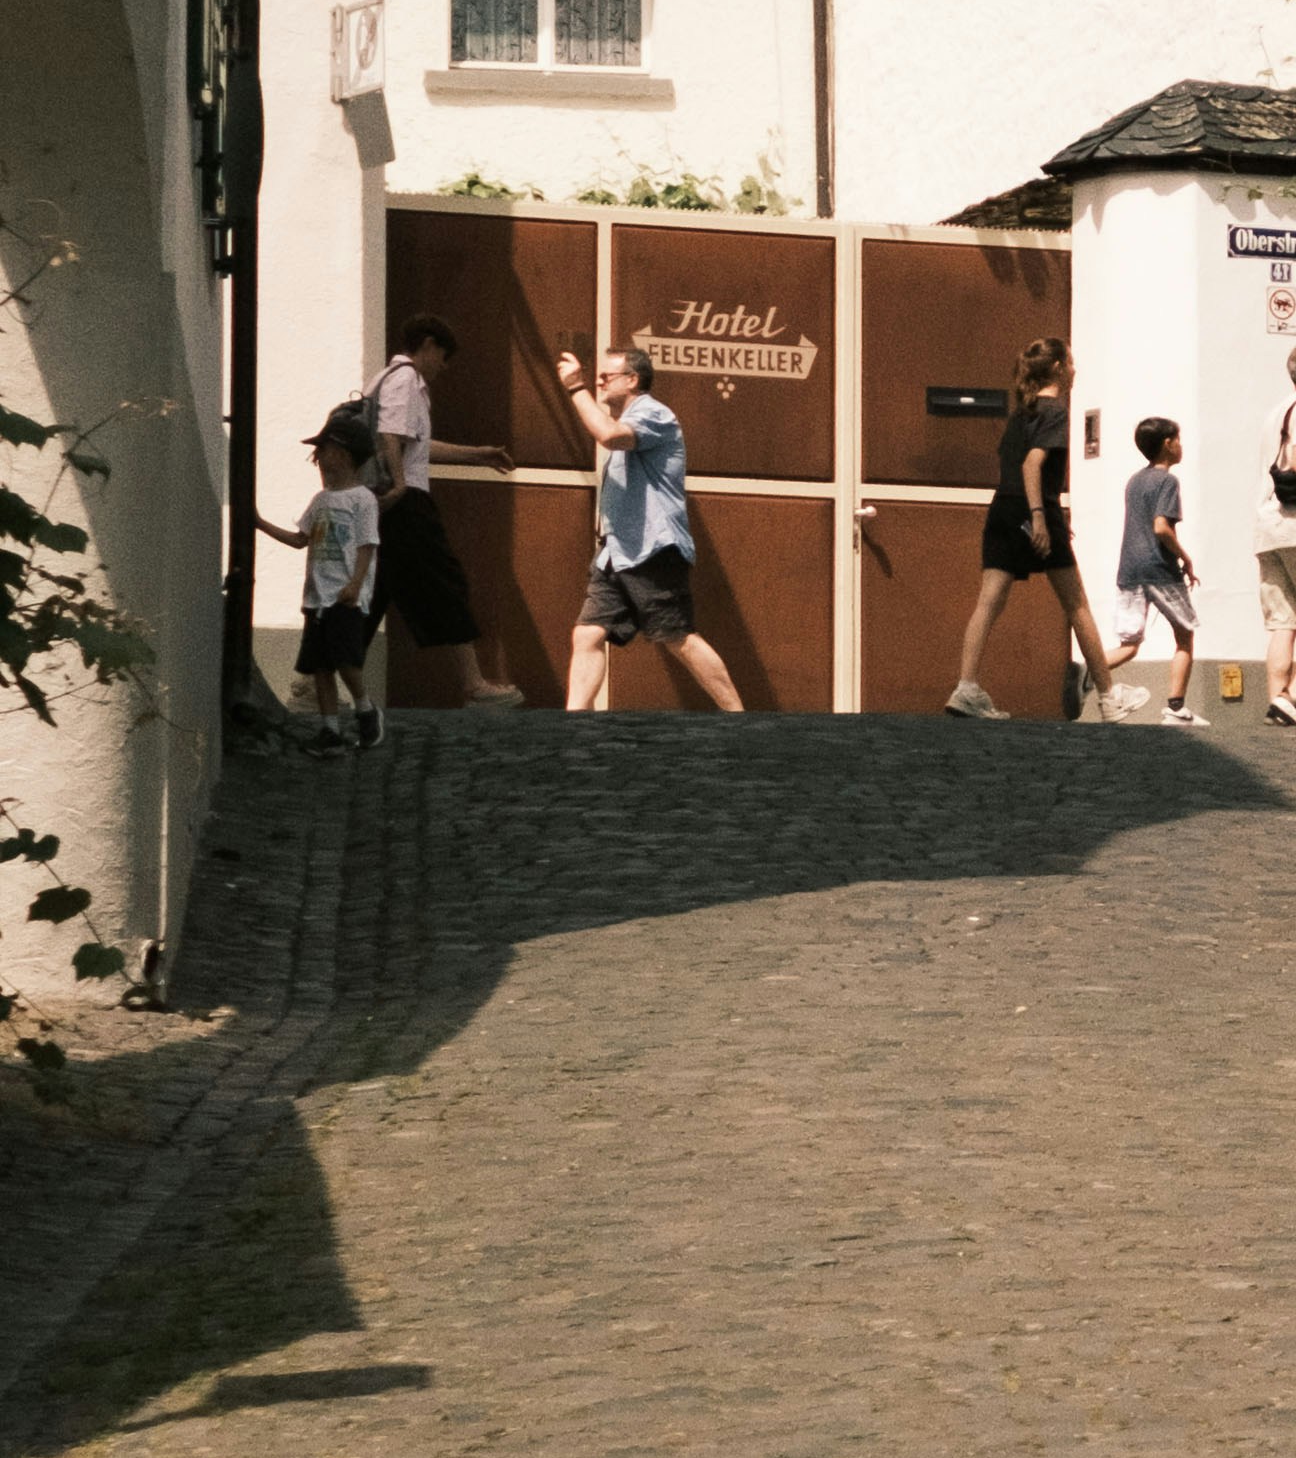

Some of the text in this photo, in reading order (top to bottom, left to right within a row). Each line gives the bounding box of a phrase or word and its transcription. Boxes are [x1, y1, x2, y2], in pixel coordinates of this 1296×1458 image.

[1272, 264, 1290, 281] 41
[667, 300, 787, 338] Hotel
[649, 343, 804, 373] FELSENKELLER
